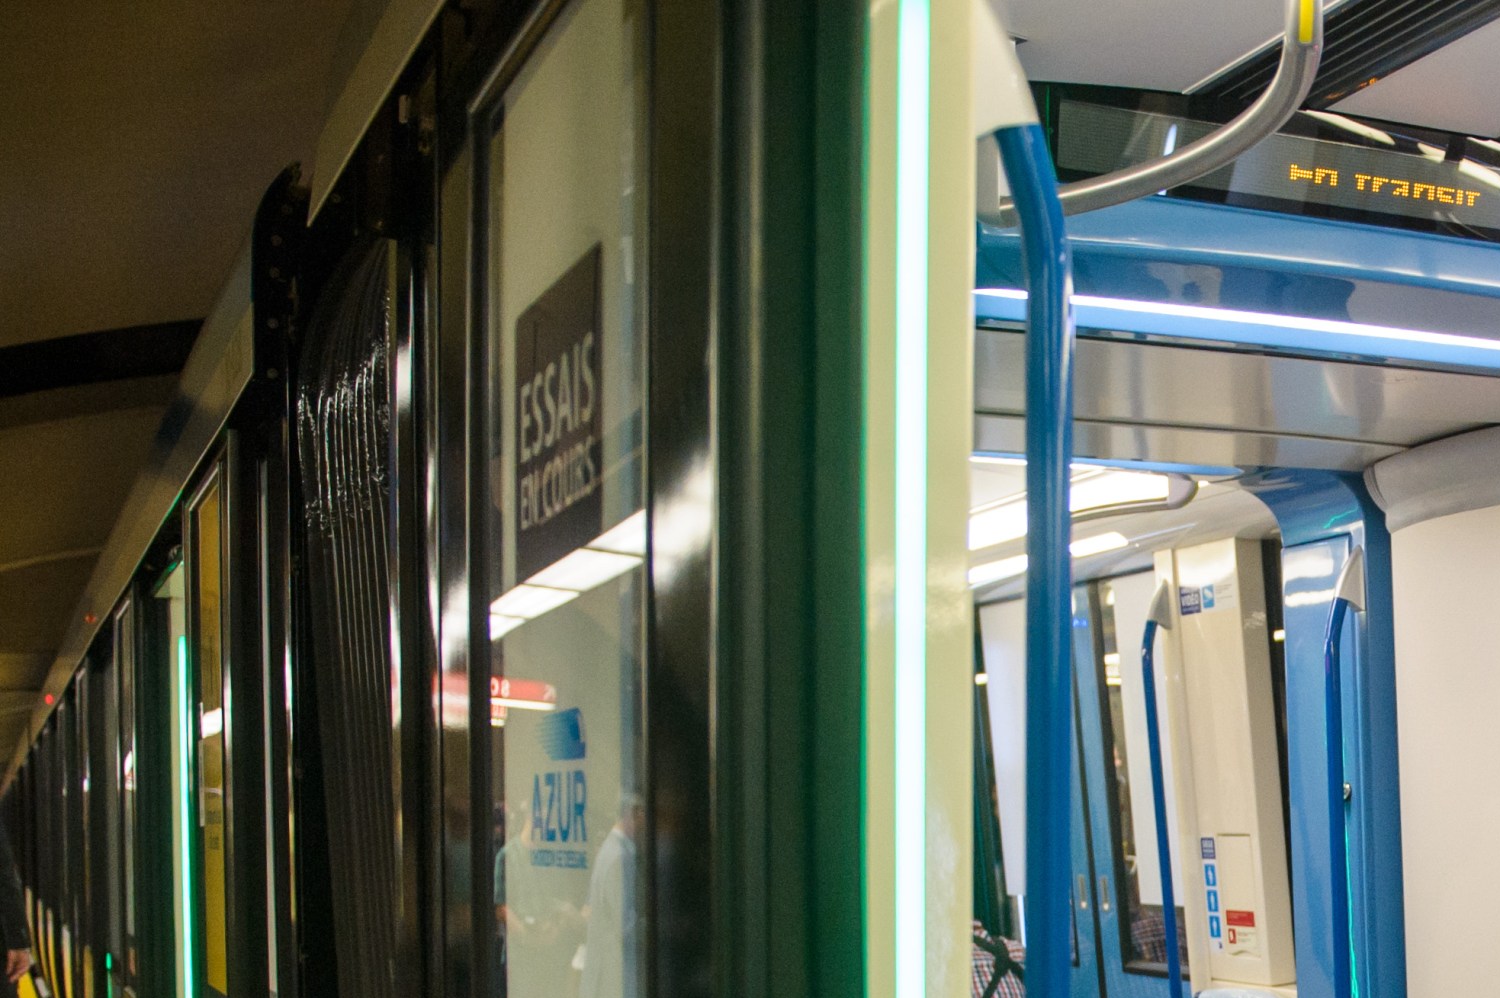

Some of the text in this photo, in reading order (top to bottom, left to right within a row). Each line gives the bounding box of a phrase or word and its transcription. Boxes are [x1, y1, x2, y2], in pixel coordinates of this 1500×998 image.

[520, 330, 595, 464] ESSAIS
[520, 469, 540, 531] EN
[531, 769, 588, 843] AZUR
